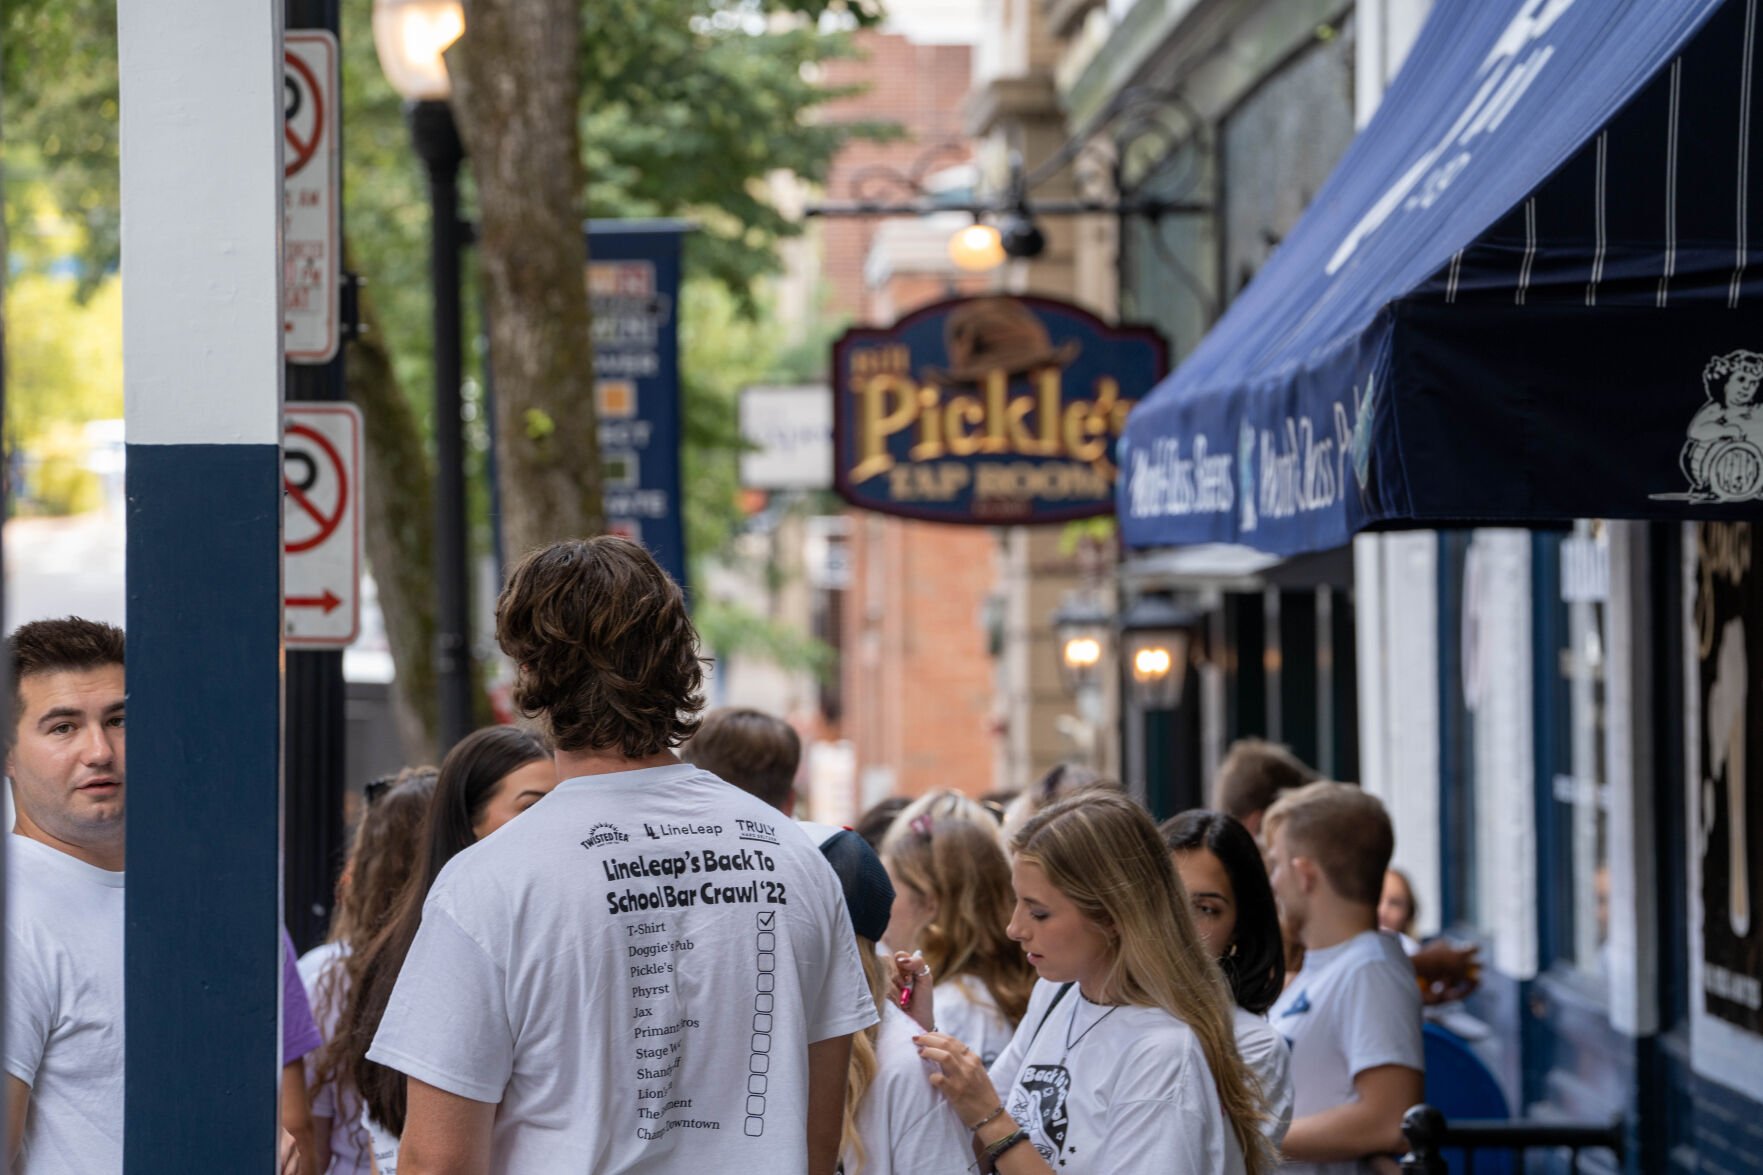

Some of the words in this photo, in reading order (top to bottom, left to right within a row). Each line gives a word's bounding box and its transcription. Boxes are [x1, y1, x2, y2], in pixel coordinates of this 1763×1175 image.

[660, 823, 723, 837] LineLeap
[735, 819, 776, 837] TRULY
[580, 832, 614, 850] TWISTED
[613, 832, 630, 842] TEA
[602, 851, 701, 881] LineLeap's
[702, 849, 754, 872] Back
[754, 850, 775, 872] To
[606, 885, 664, 915] School
[663, 885, 697, 908] Bar
[700, 881, 758, 904] Crawl
[626, 922, 667, 937] T-Shirt
[628, 941, 675, 957] Doggie's
[674, 939, 694, 952] Pub
[630, 962, 674, 978] Pickle's
[632, 984, 670, 998] Phyrst
[632, 1007, 654, 1019] Jax
[634, 1024, 681, 1039] Primant
[636, 1047, 669, 1060] Stage
[637, 1086, 668, 1100] Lion
[636, 1107, 661, 1120] The
